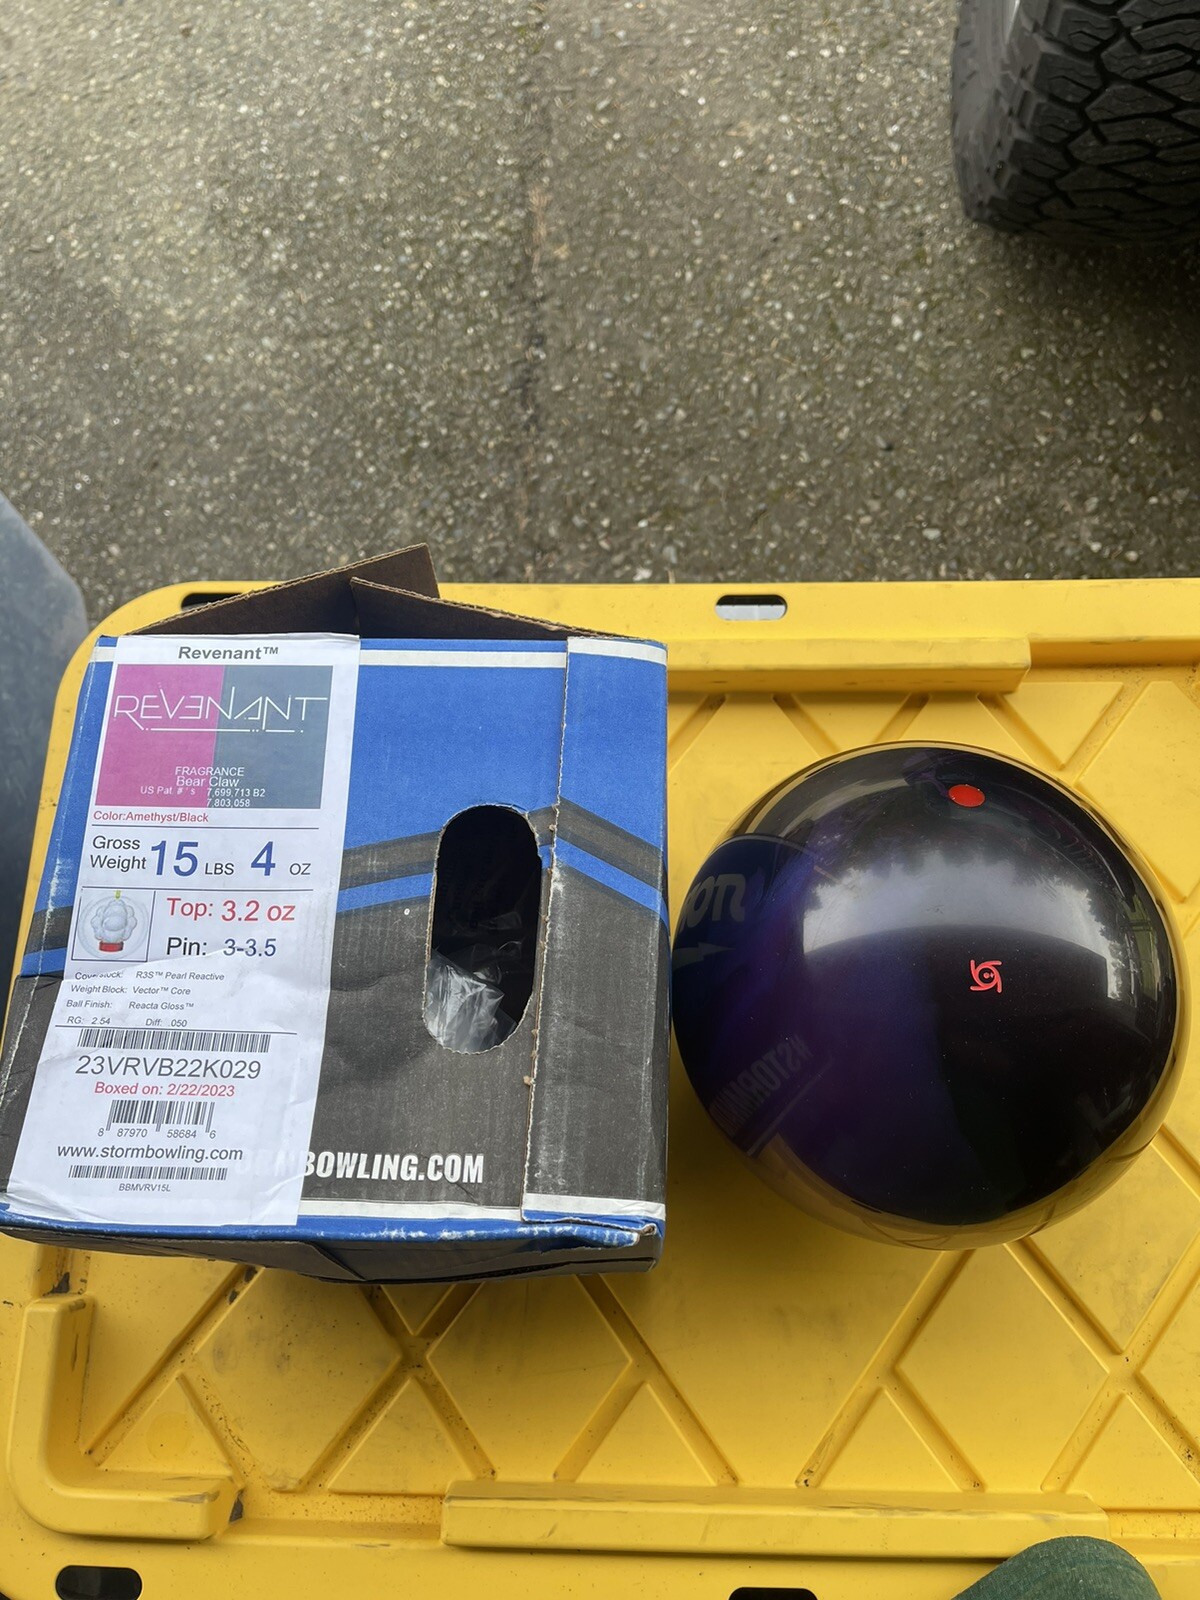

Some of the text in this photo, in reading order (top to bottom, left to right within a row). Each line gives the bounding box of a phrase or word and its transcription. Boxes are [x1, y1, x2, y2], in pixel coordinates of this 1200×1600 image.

[113, 684, 328, 732] REVENANT
[175, 766, 245, 777] FRAGRANCE
[176, 776, 240, 788] Bear Claw
[140, 786, 155, 795] US
[252, 789, 266, 798] B2
[93, 811, 209, 824] Color:Amethyst/Black
[92, 836, 141, 851] Gross
[90, 855, 148, 872] Weight
[151, 840, 199, 877] 15
[204, 862, 235, 876] LBS
[250, 841, 276, 877] 4
[167, 898, 296, 922] Top: 3.2 oz
[166, 937, 277, 957] Pin: 3-3.5
[165, 971, 187, 980] Pearl
[189, 972, 225, 981] Reactive
[71, 985, 101, 995] Weight
[102, 985, 128, 994] Block:
[170, 987, 191, 996] Core
[66, 1000, 83, 1009] Ball
[84, 1000, 113, 1009] Finish:
[128, 1001, 159, 1010] Reacta
[66, 1016, 84, 1025] RG:
[145, 1018, 163, 1027] Diff:
[75, 1055, 261, 1079] 23VRVB22K029
[94, 1081, 235, 1097] Boxed on: 2/22/2023
[97, 1127, 216, 1139] 8 87970 58684 6
[57, 1145, 243, 1163] www.stormbowling.com
